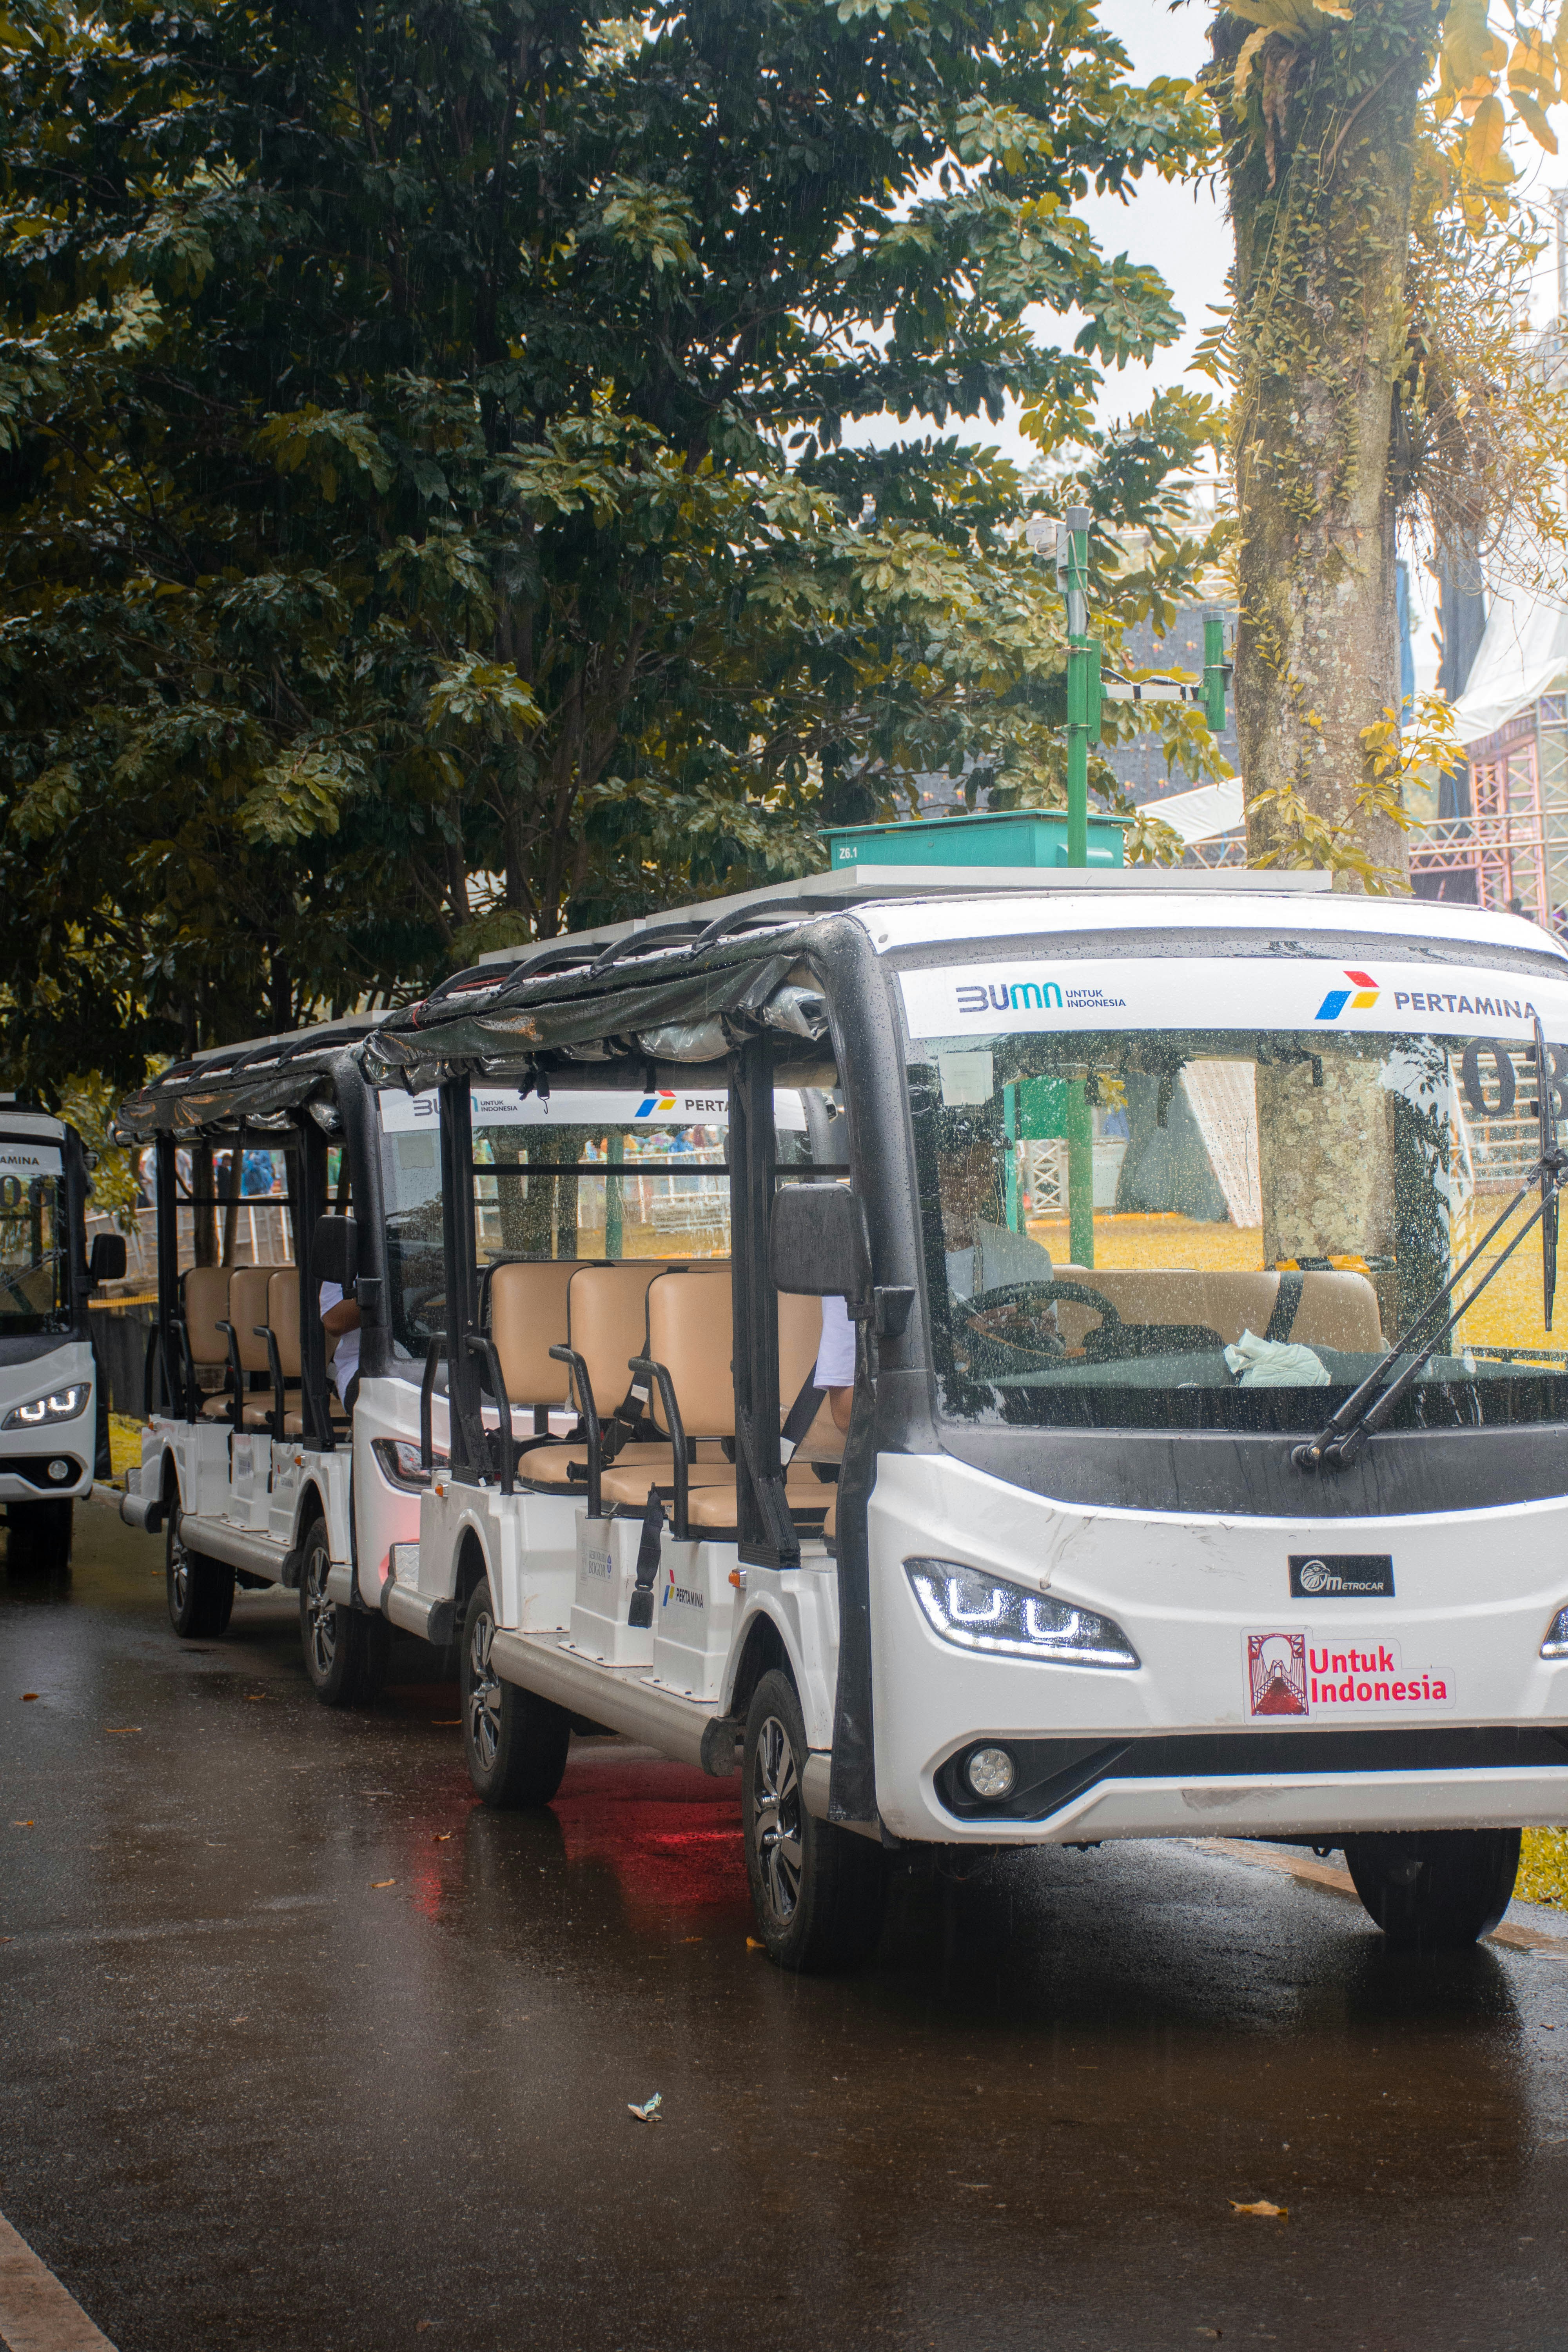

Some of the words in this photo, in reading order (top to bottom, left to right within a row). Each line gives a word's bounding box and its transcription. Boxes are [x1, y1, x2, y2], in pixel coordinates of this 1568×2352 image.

[839, 847, 857, 859] Z6.1
[1065, 989, 1103, 998] UNTUK
[1067, 999, 1127, 1007] INDONESIA
[1394, 992, 1538, 1019] PERTAMINA
[589, 1561, 606, 1578] BOGOR
[1326, 1576, 1384, 1590] METROCAR
[676, 1588, 703, 1608] PERTAMINA
[1309, 1645, 1395, 1674] Untuk
[1311, 1674, 1447, 1703] Indonesia
